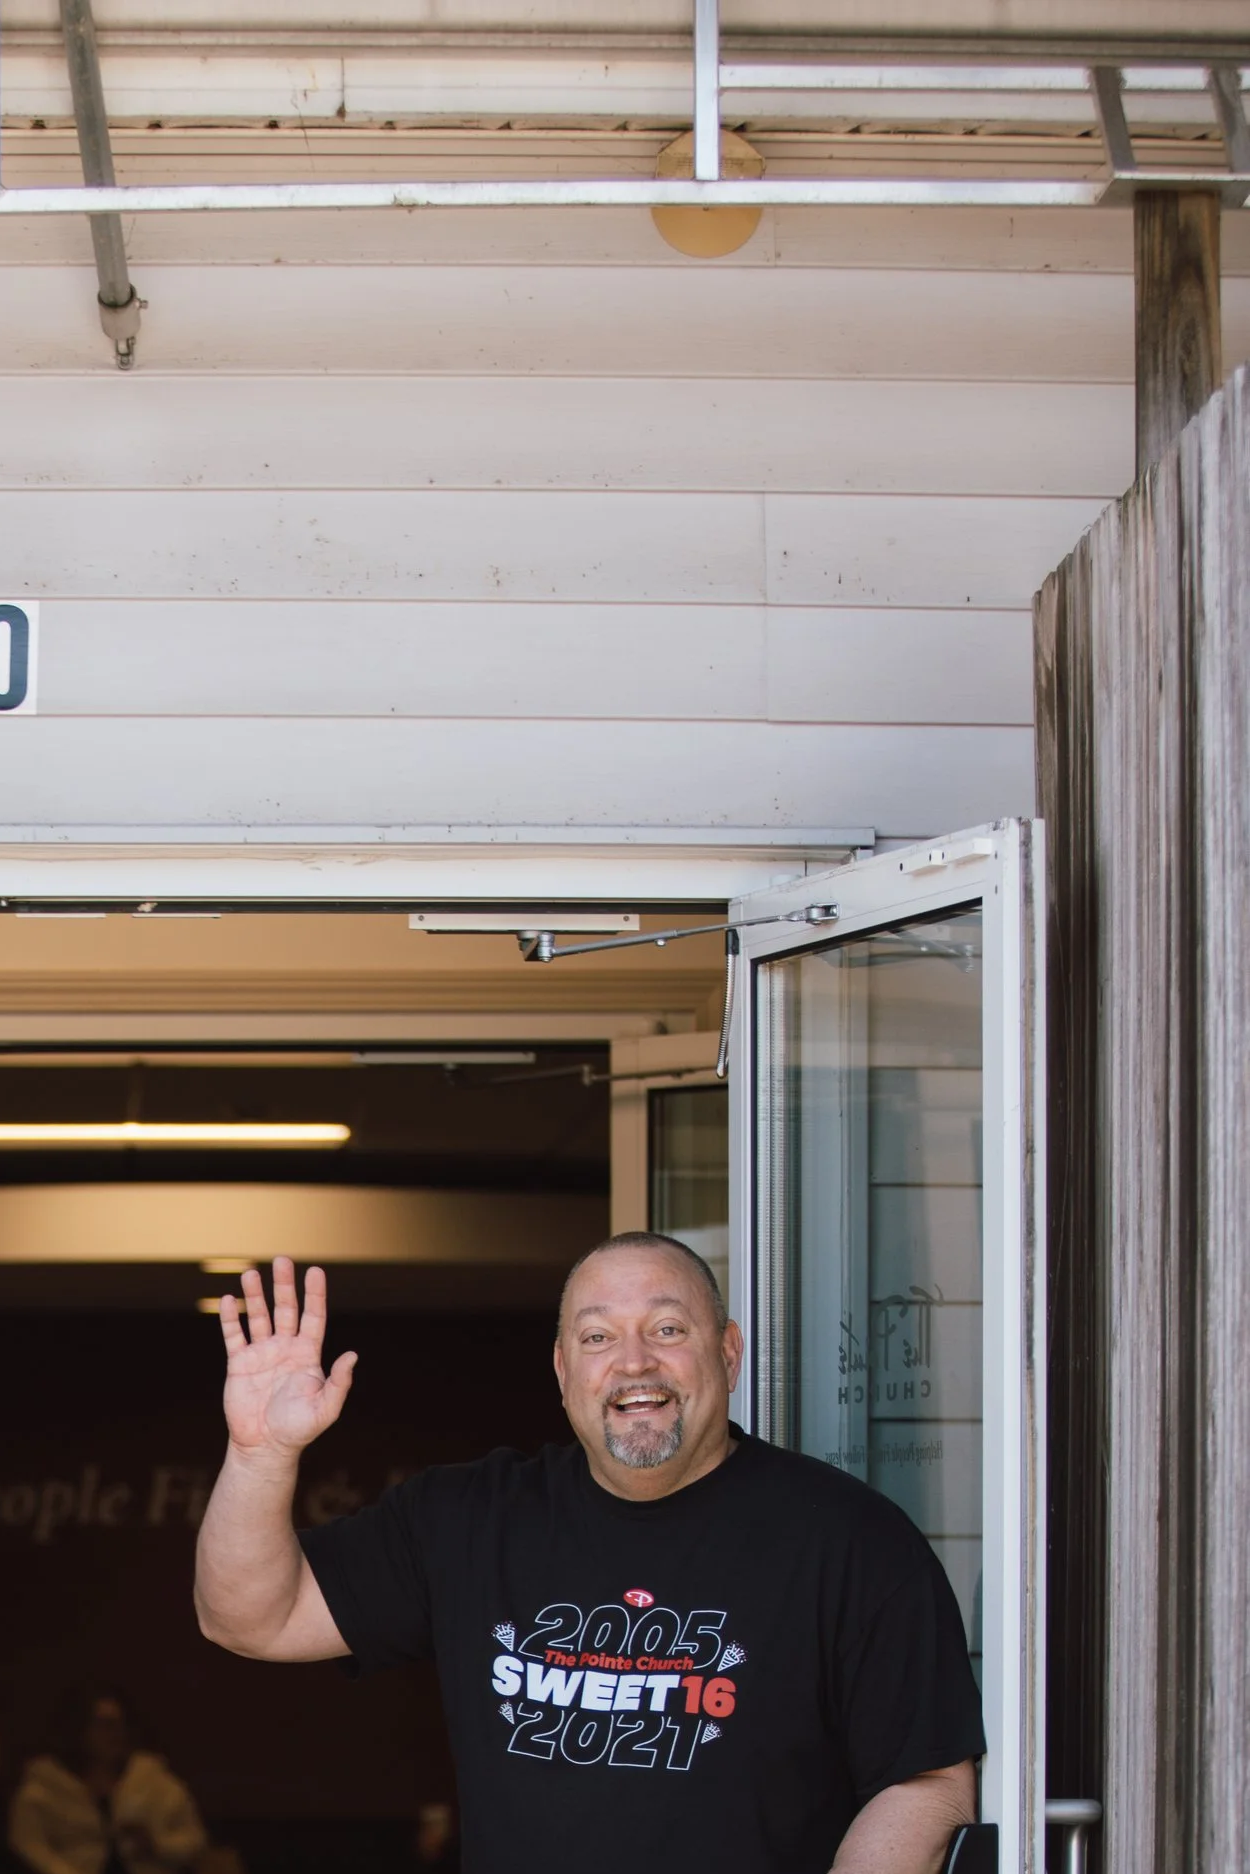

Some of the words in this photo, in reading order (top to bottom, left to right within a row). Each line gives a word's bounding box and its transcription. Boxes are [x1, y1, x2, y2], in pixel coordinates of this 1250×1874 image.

[517, 1603, 728, 1670] 2005
[544, 1650, 577, 1667] The
[579, 1651, 633, 1671] Pointe
[635, 1656, 695, 1672] Church
[491, 1654, 681, 1713] SWEET
[681, 1675, 737, 1719] 16
[507, 1702, 703, 1771] 2021
